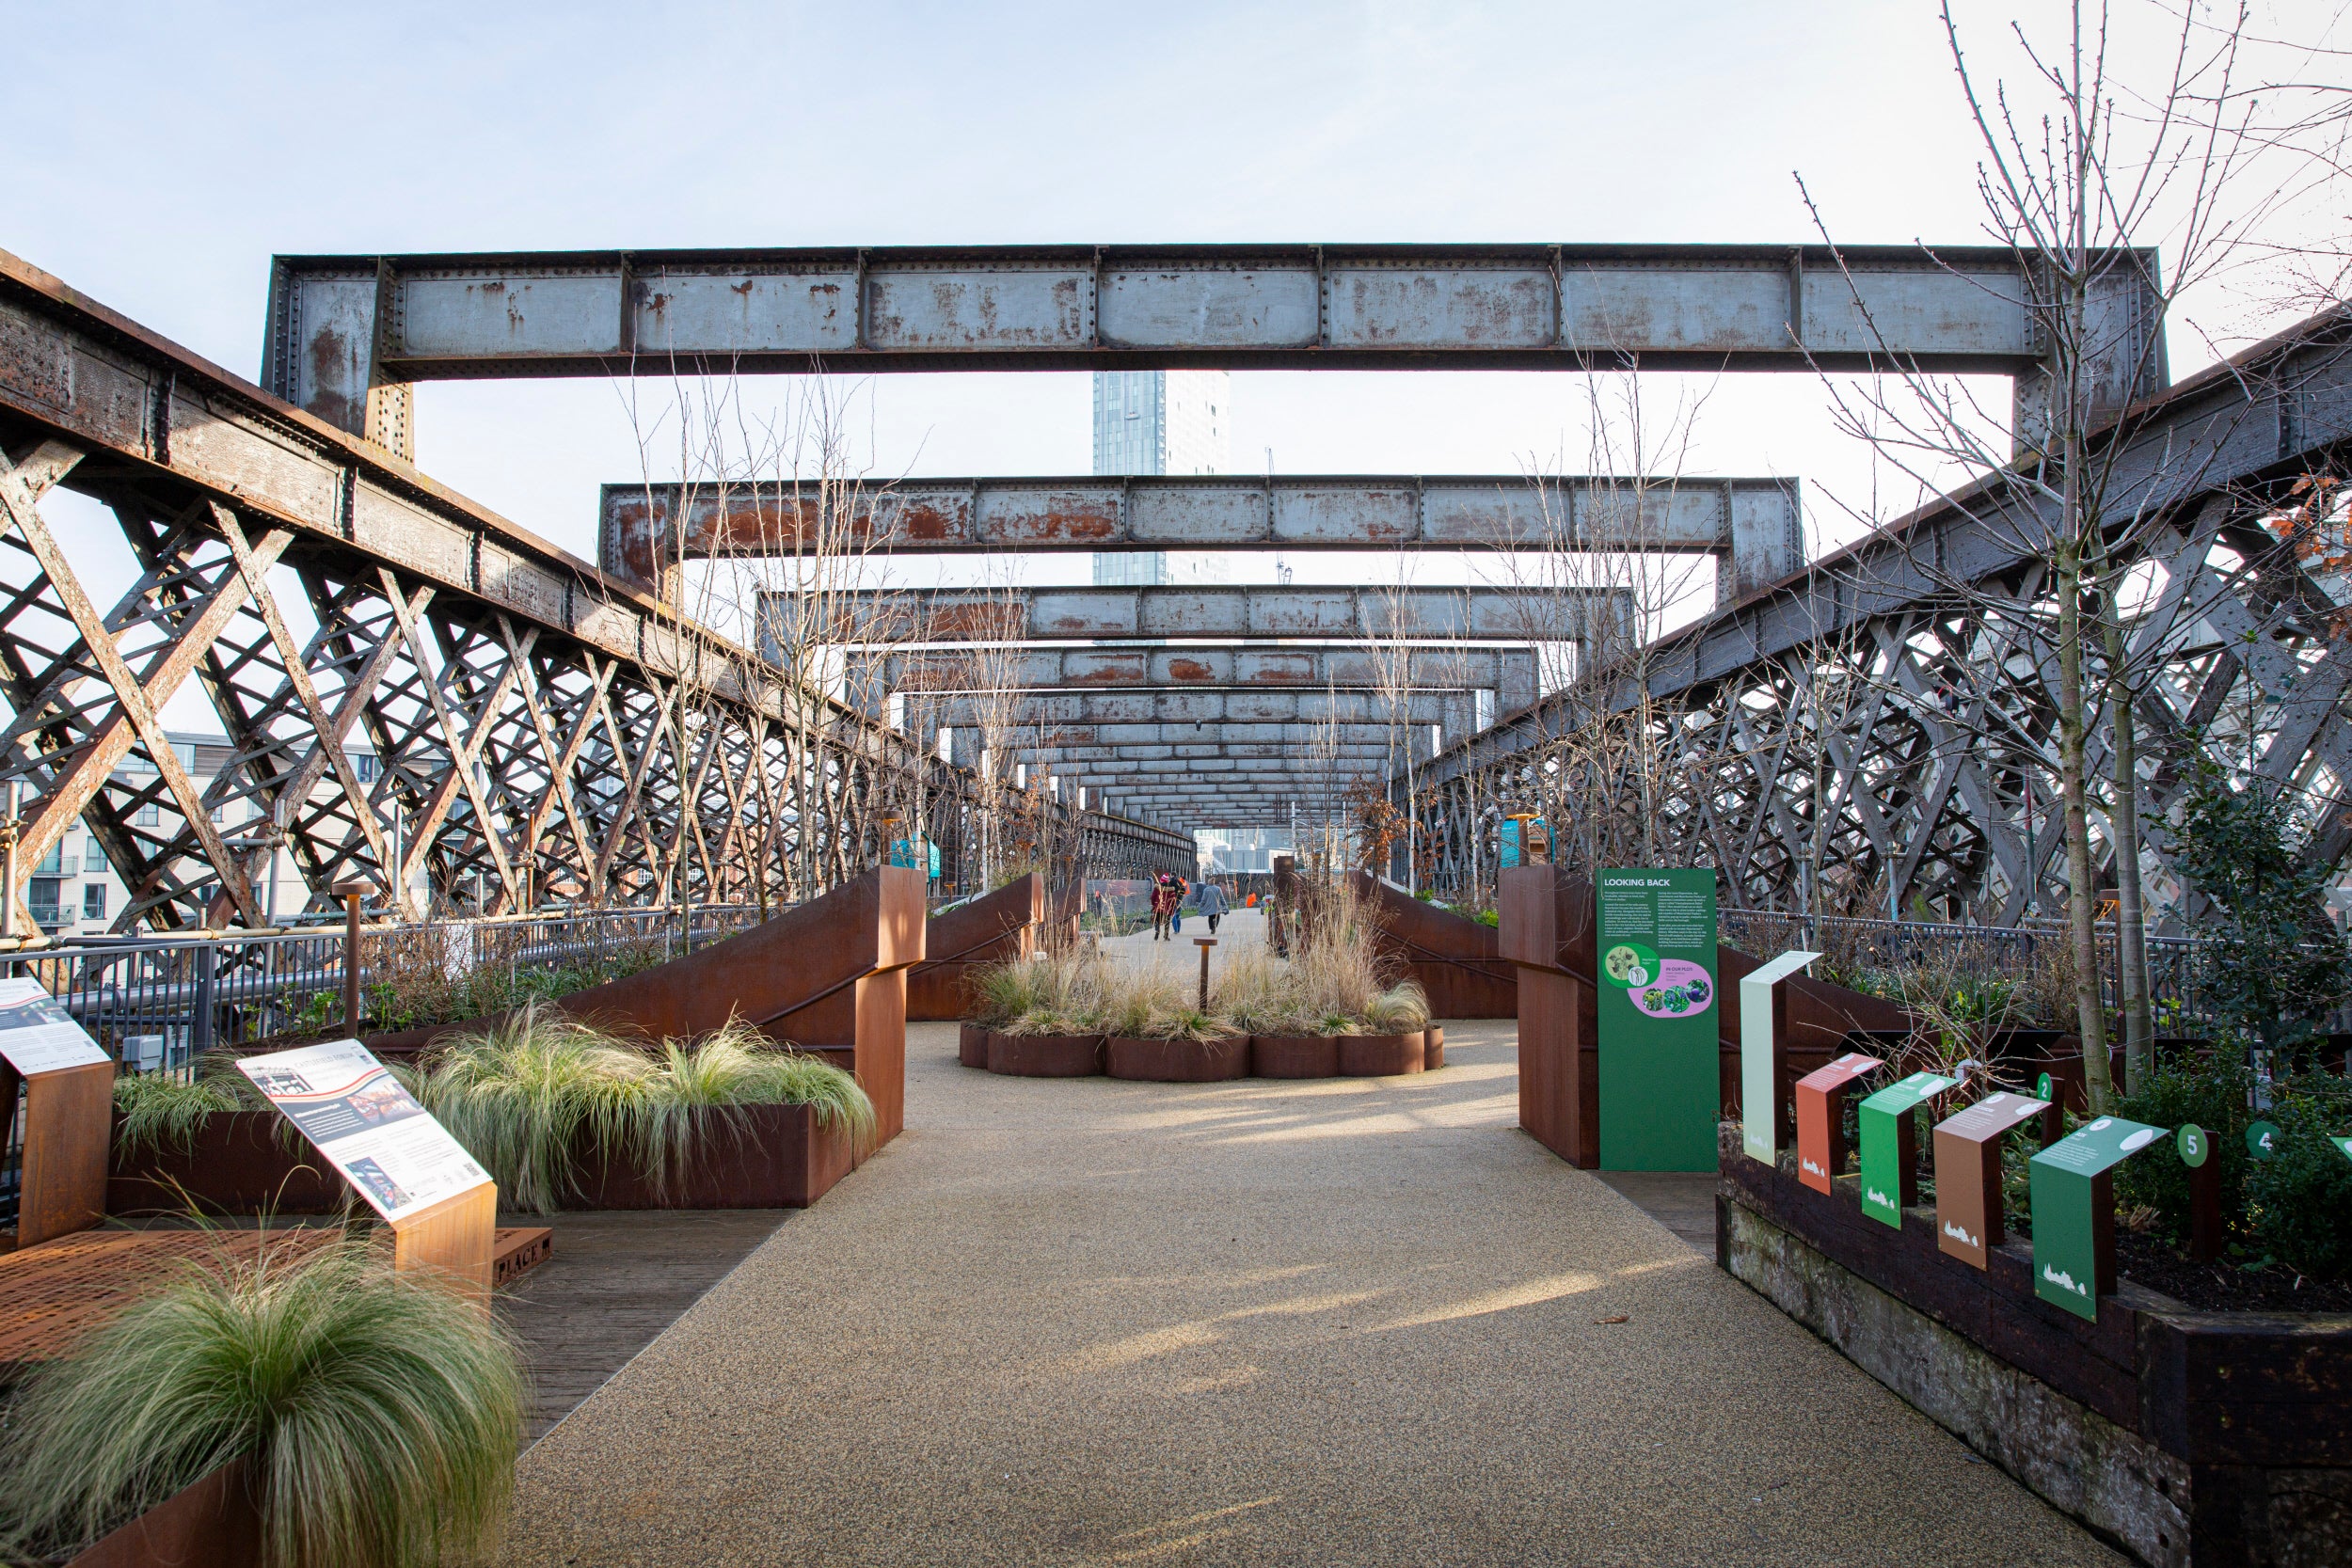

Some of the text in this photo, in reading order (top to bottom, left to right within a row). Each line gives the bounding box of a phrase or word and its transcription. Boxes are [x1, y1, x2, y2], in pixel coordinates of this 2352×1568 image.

[1604, 879, 1671, 887] LOOKING BACK
[2041, 1081, 2048, 1099] 2
[2186, 1134, 2198, 1155] 5
[2258, 1132, 2273, 1151] 4
[499, 1243, 538, 1282] PLACE
